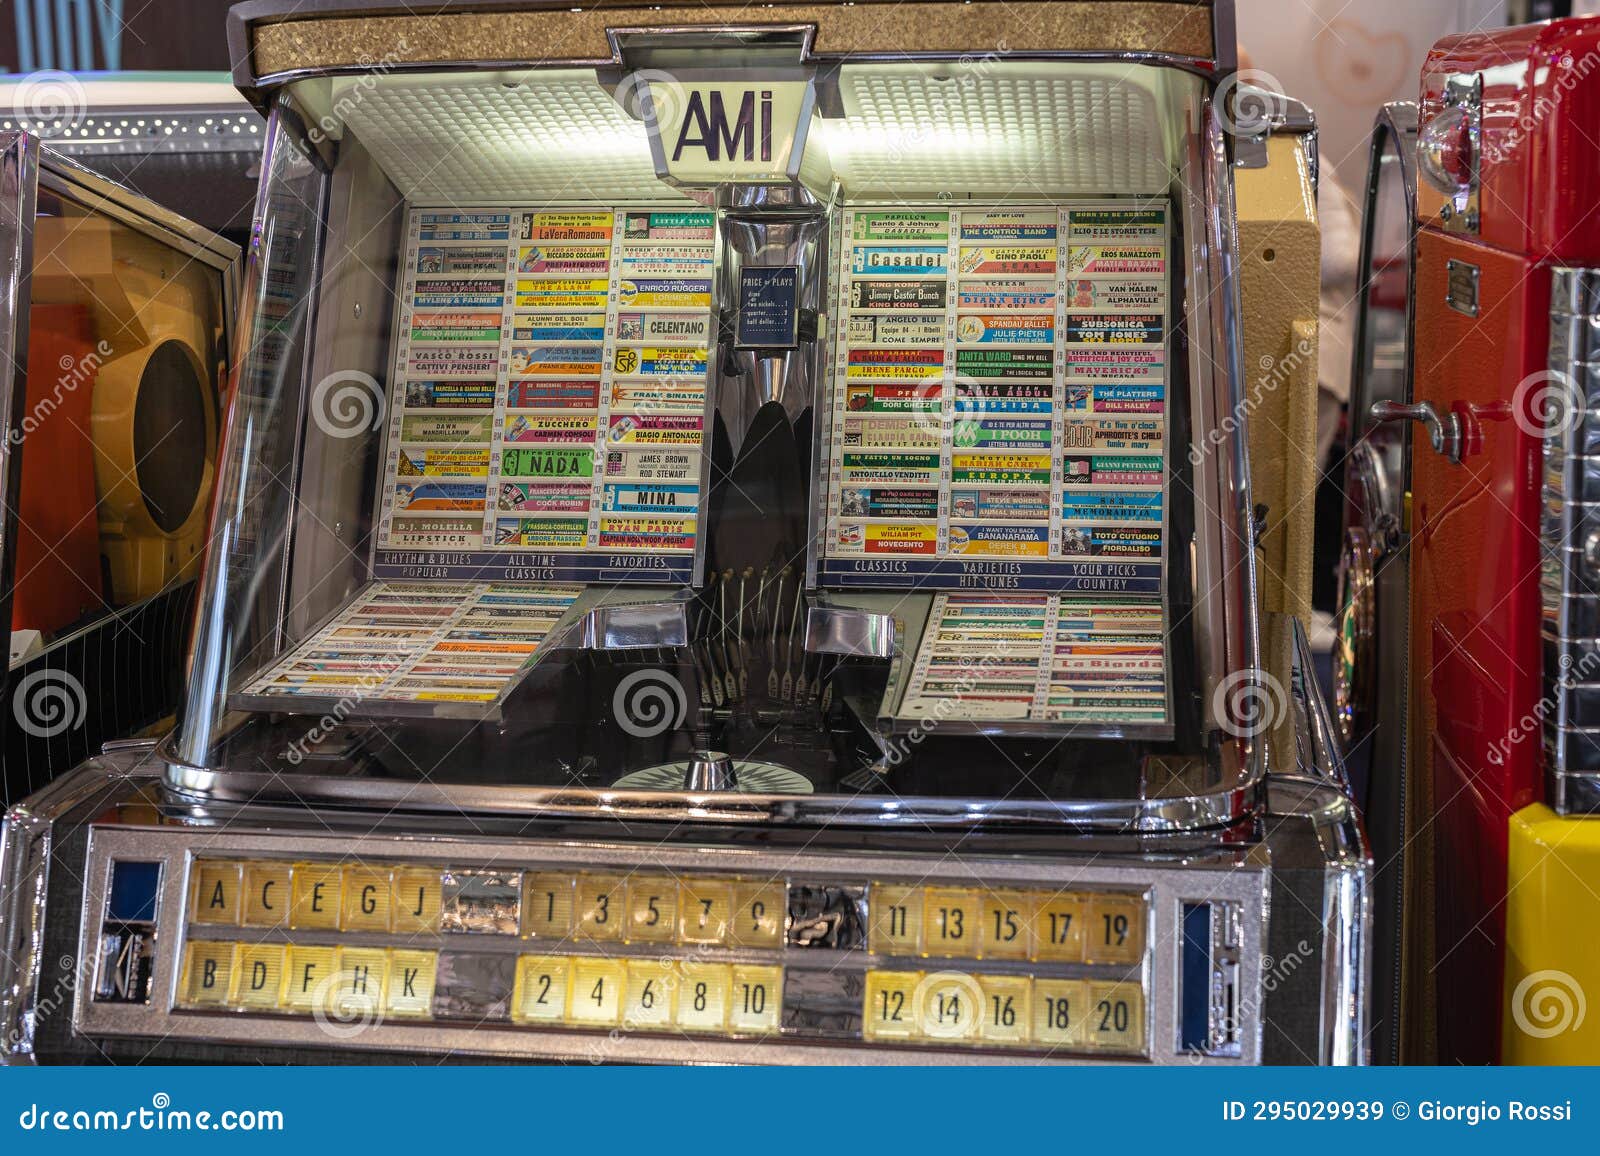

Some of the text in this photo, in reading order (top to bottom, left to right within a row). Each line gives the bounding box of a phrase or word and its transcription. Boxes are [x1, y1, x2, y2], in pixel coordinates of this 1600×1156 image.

[871, 253, 941, 267] Casadei
[743, 278, 793, 286] PRICE PLAYS
[868, 289, 939, 300] Jimmy Castor Bunch
[650, 322, 704, 333] CELENTANO
[960, 352, 1011, 361] ANITA WARD
[1100, 421, 1111, 429] it's
[1115, 421, 1128, 429] five
[1001, 430, 1041, 440] POOH
[1095, 431, 1139, 439] APHRODITE'S
[1106, 440, 1125, 448] funky
[639, 455, 688, 463] JAMES BROWN
[530, 457, 580, 473] NADA
[639, 470, 688, 478] ROD STEWART
[637, 492, 676, 505] MINA
[385, 552, 471, 564] RHYTHM & BLUES
[509, 556, 556, 566] ALL TIME
[609, 556, 665, 567] FAVORITES
[855, 561, 908, 572] CLASSICS
[963, 563, 1021, 574] VARIETIES
[1073, 564, 1137, 576] YOUR PICKS
[402, 567, 448, 578] POPULAR
[505, 568, 554, 579] CLASSICS
[960, 576, 1018, 587] HIT TUNES
[1077, 579, 1127, 590] COUNTRY
[211, 880, 424, 916] A C E G J
[547, 892, 555, 922] 1
[595, 894, 608, 924] 3
[647, 896, 659, 926] 5
[700, 900, 713, 929] 7
[889, 905, 1128, 946] 11 13 15 17 19
[203, 959, 417, 997] B D F H K
[537, 975, 766, 1014] 2 4 6 8 10
[881, 990, 1129, 1032] 12 14 16 18 20
